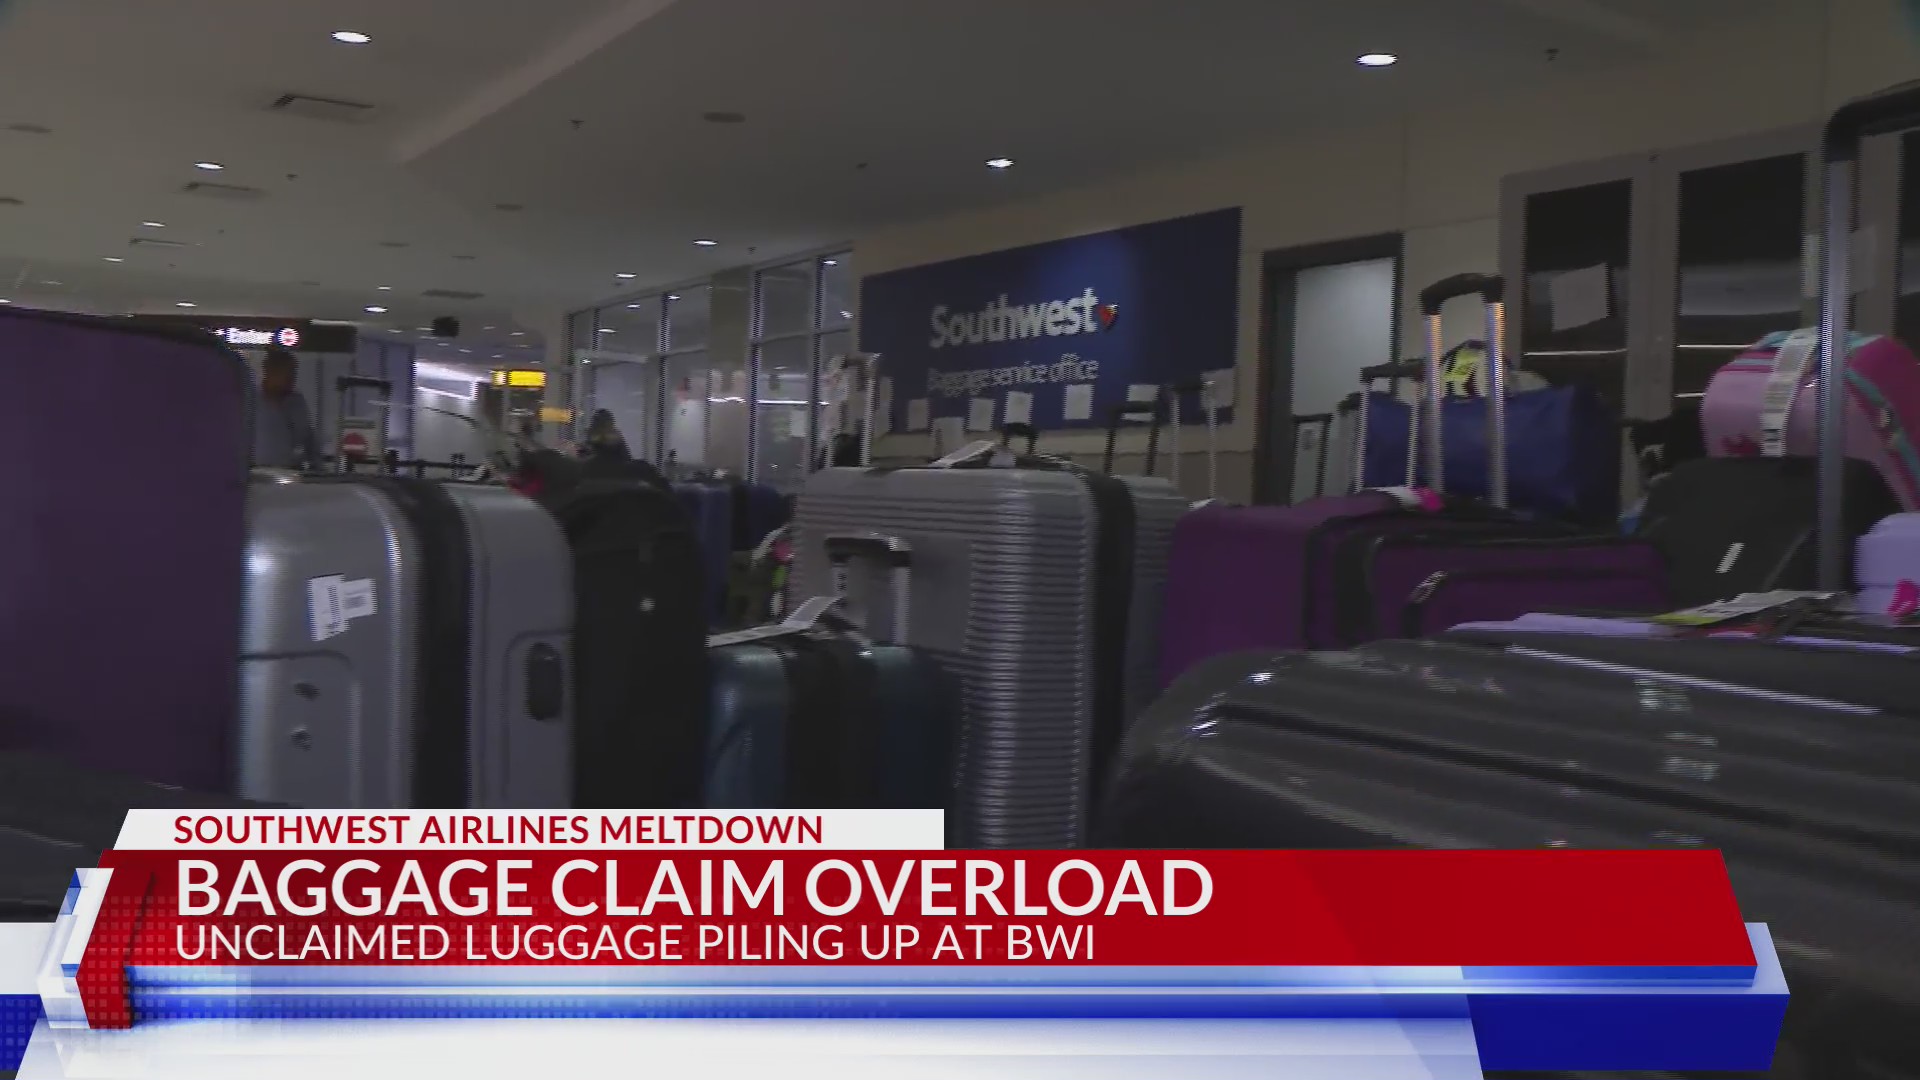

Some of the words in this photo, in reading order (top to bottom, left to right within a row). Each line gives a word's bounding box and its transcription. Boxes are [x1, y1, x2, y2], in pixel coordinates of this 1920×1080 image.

[226, 327, 274, 345] Enter
[929, 287, 1099, 349] Southwest
[927, 366, 990, 398] Baggage
[990, 361, 1048, 387] service
[1048, 352, 1099, 383] office
